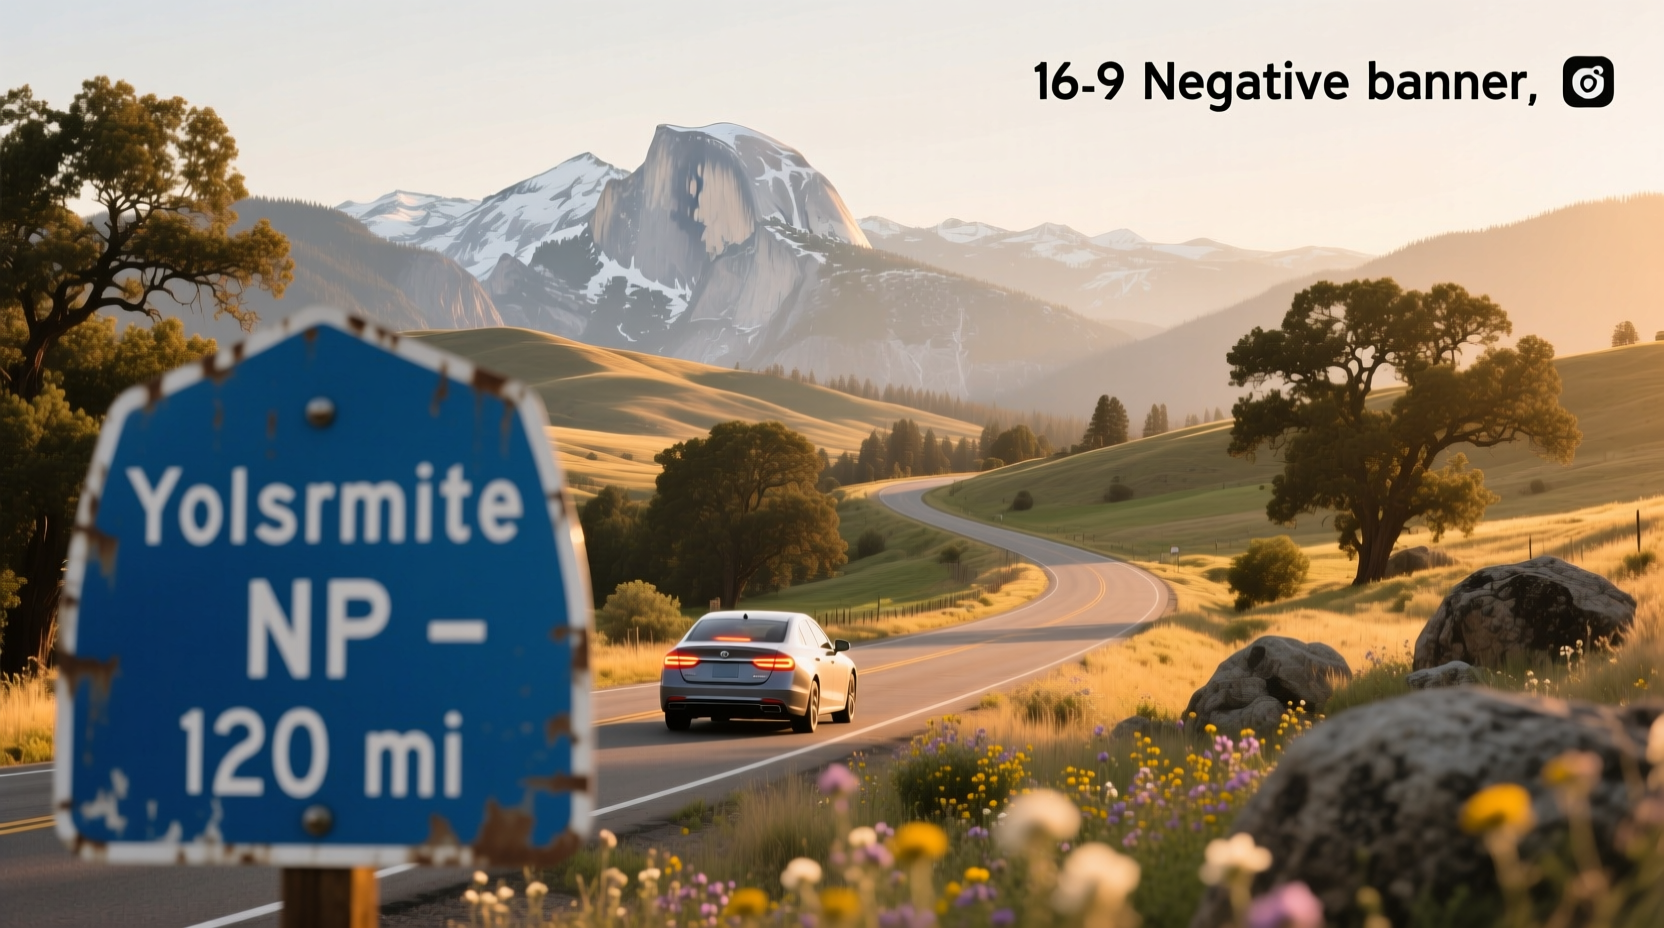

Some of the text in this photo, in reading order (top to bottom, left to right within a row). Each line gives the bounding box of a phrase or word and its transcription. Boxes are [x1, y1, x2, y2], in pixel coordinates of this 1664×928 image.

[126, 462, 523, 545] Yolsrmite
[247, 578, 392, 680] NP
[180, 707, 462, 798] 120 mi
